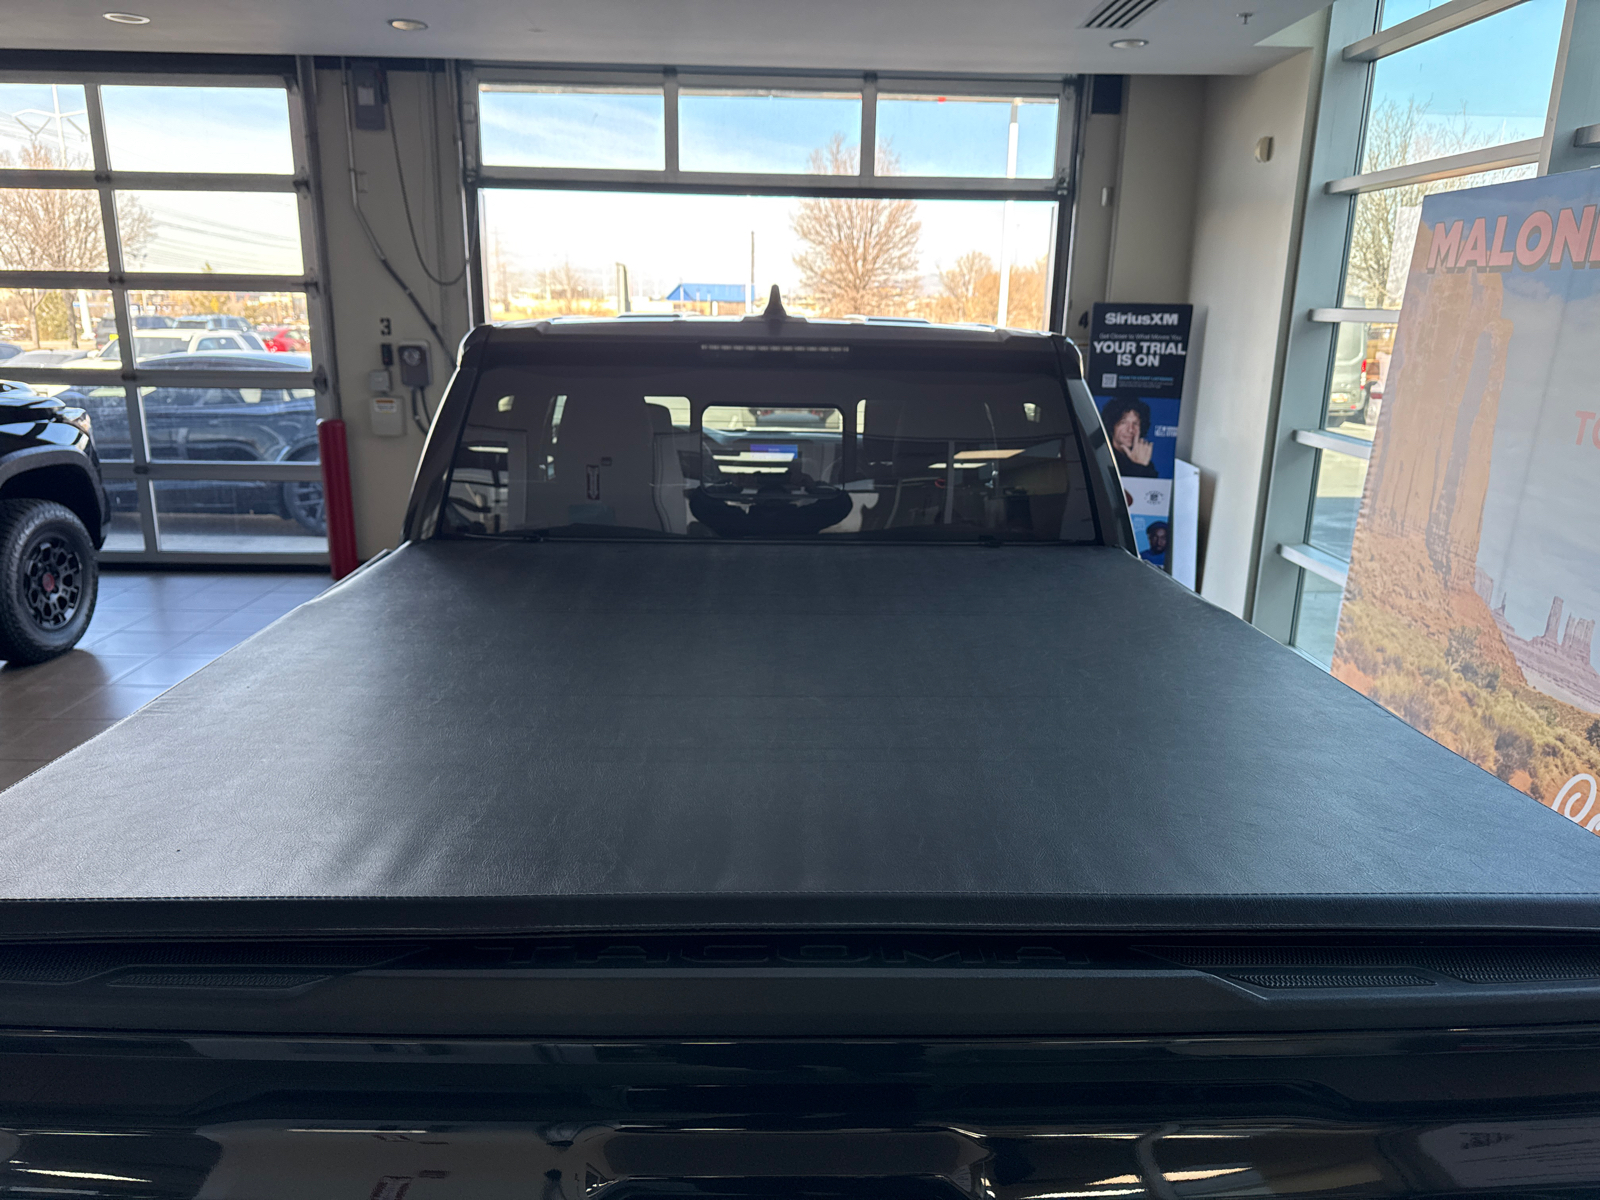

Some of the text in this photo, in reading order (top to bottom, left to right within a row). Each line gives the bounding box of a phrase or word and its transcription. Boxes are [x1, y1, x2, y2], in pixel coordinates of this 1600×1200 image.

[1078, 311, 1089, 328] 4
[1104, 312, 1179, 325] SiriusXM
[380, 318, 391, 336] 3
[1093, 341, 1187, 355] YOUR TRIAL
[1116, 354, 1160, 367] IS ON
